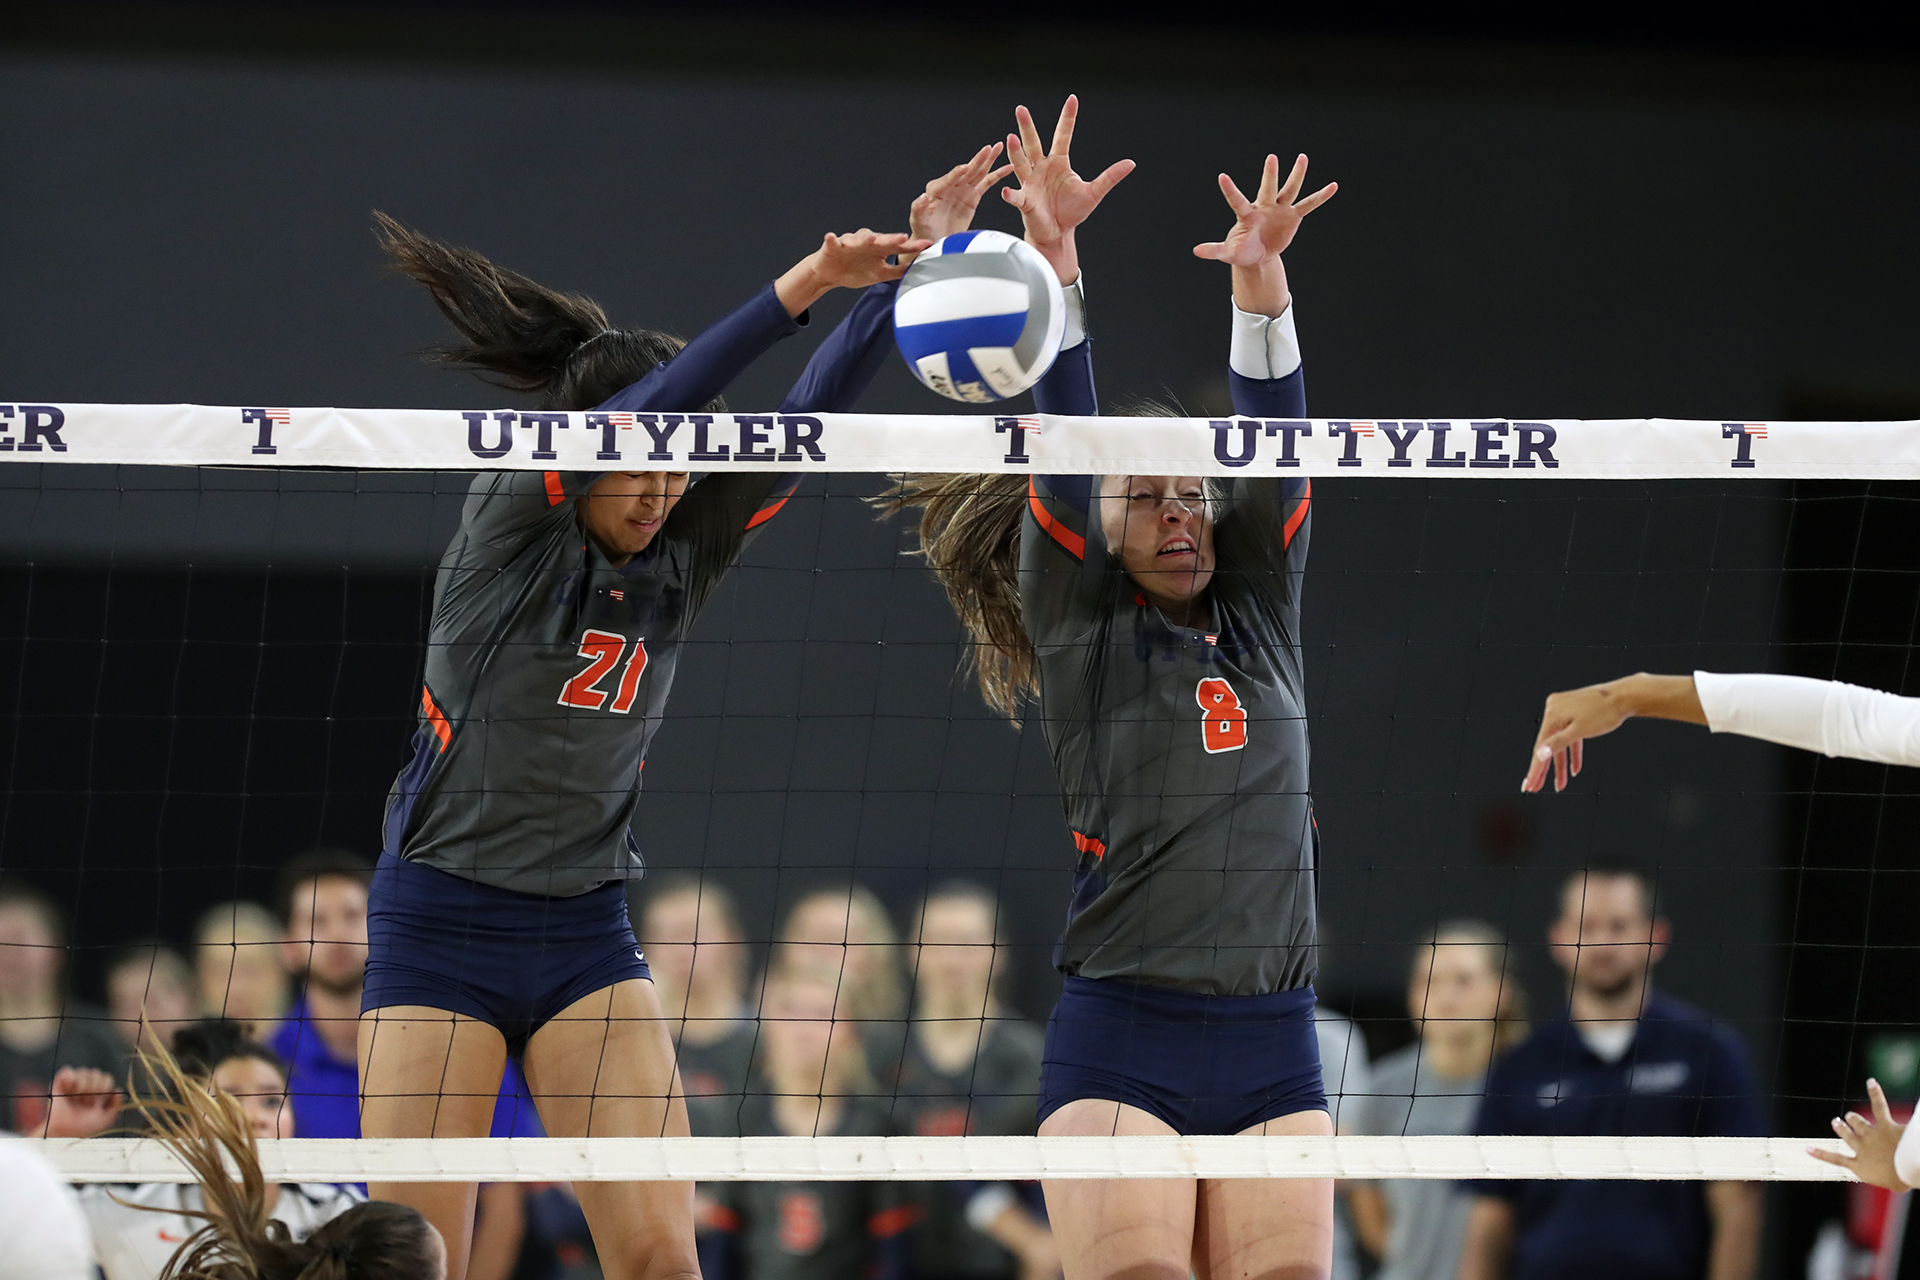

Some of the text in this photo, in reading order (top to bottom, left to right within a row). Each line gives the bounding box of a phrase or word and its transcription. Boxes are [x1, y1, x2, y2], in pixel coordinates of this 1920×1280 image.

[461, 412, 826, 462] UT TYLER
[1208, 420, 1559, 469] UT TYLER
[557, 628, 649, 715] 21
[1195, 677, 1249, 754] 8
